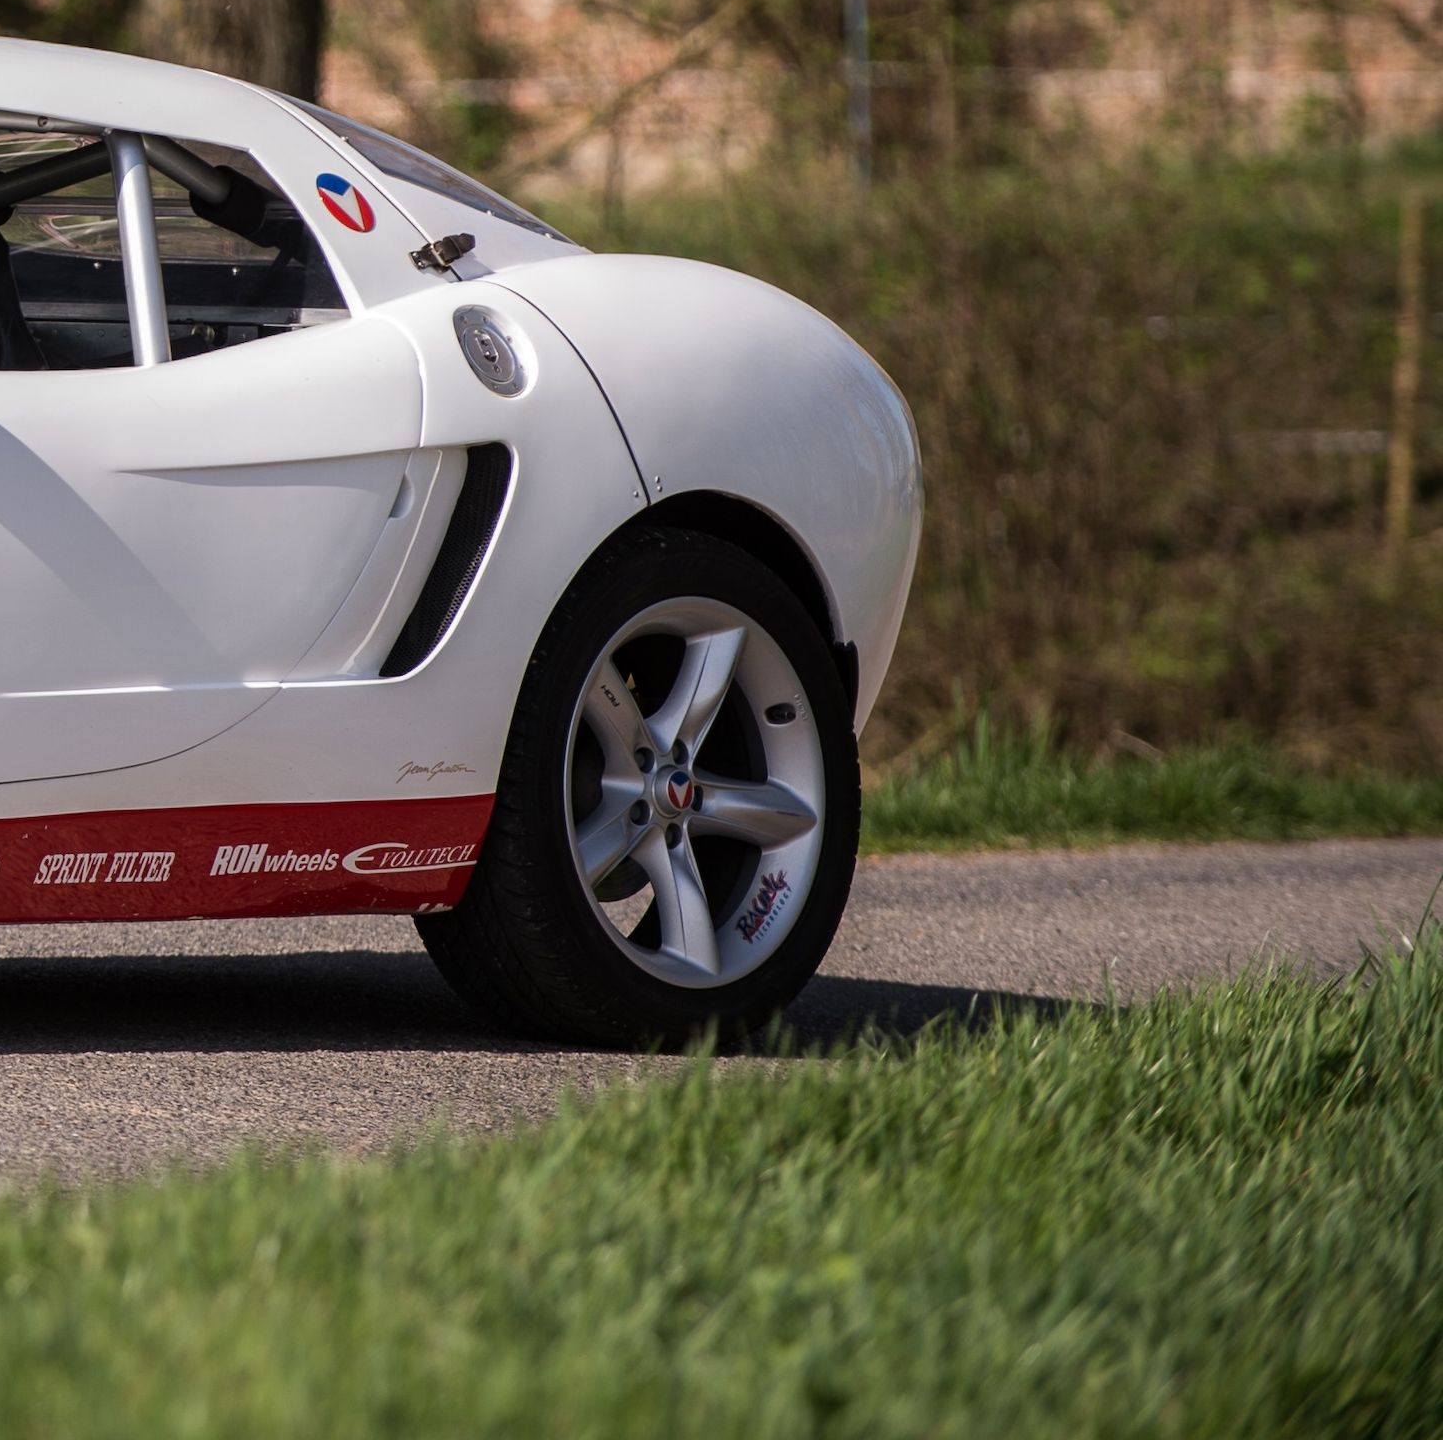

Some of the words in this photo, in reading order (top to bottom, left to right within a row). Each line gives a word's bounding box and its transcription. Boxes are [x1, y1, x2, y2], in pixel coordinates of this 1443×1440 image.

[33, 853, 108, 885] SPRINT
[104, 851, 176, 883] FILTER
[209, 843, 268, 876] ROH
[264, 849, 340, 873] wheels
[341, 842, 478, 874] EVOLUTECH
